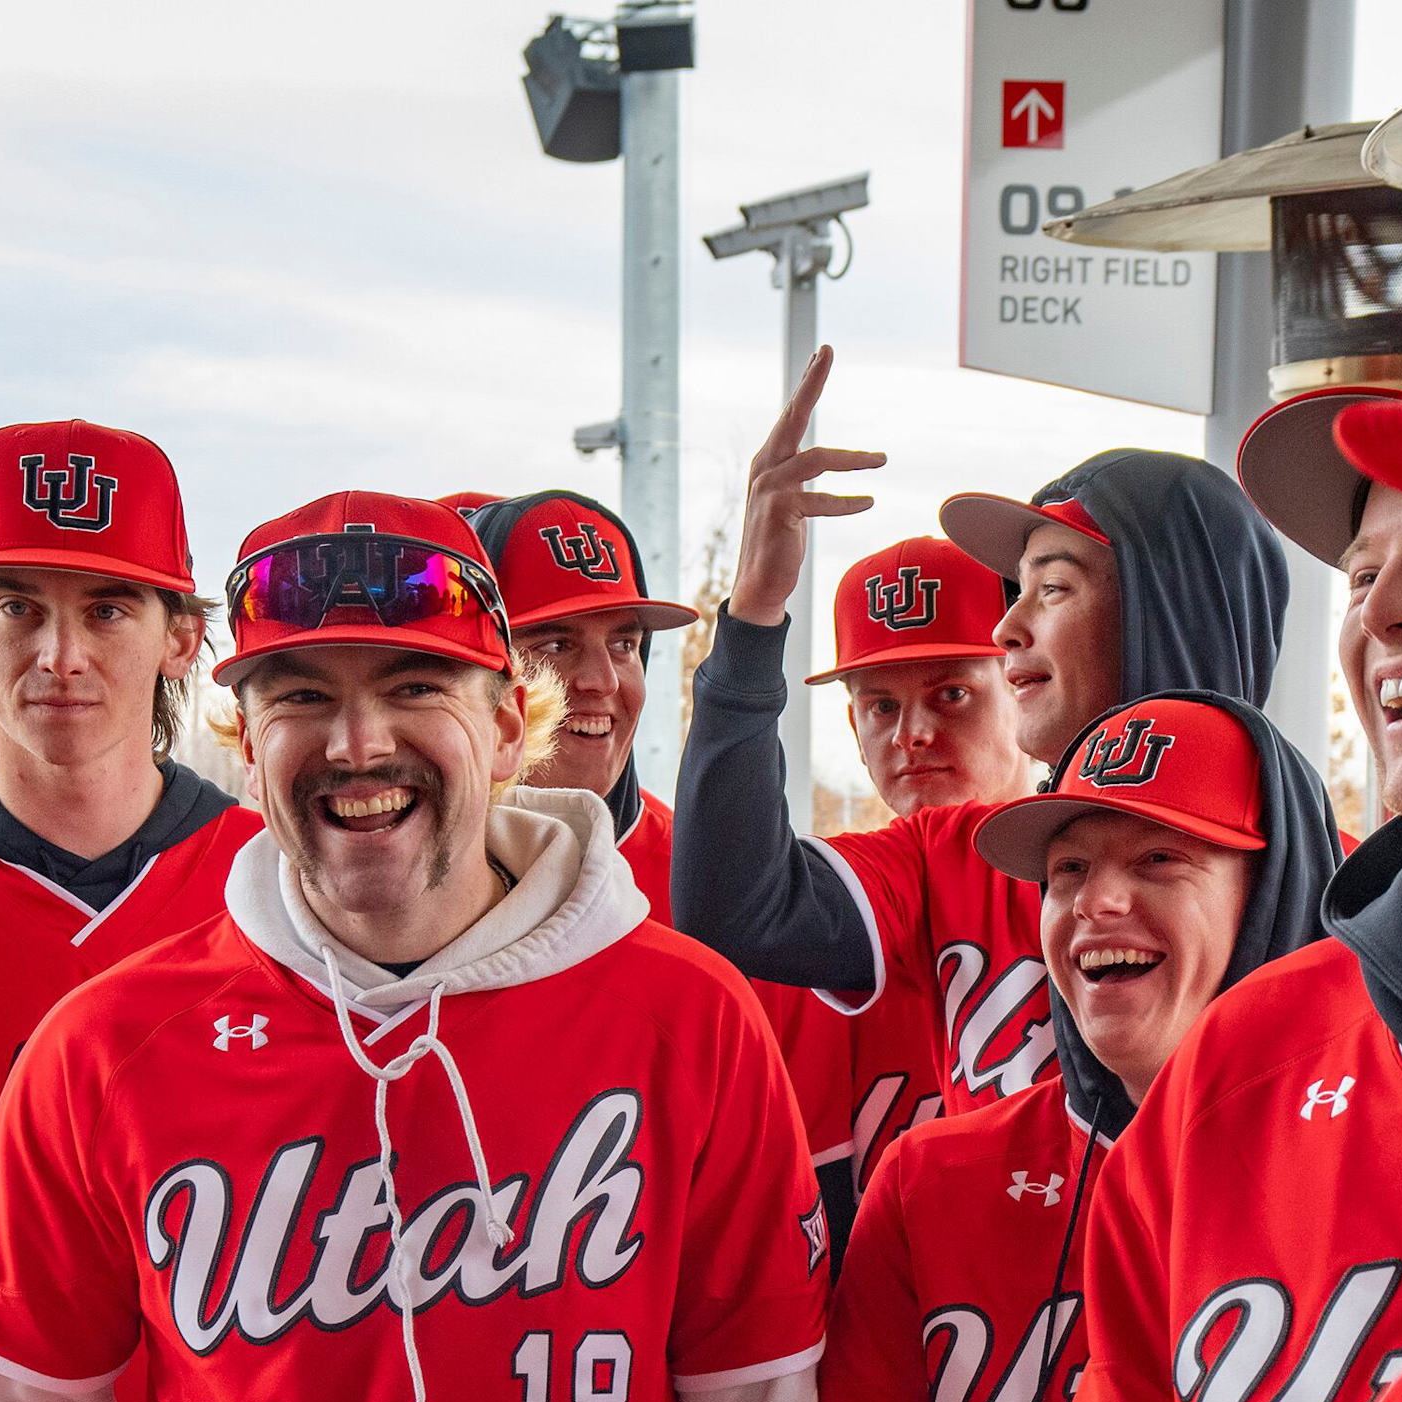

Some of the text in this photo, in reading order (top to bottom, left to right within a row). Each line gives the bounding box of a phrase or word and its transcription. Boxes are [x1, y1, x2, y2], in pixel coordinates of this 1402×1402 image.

[999, 256, 1191, 286] RIGHT FIELD
[999, 297, 1082, 324] DECK
[145, 1087, 645, 1358] Utah
